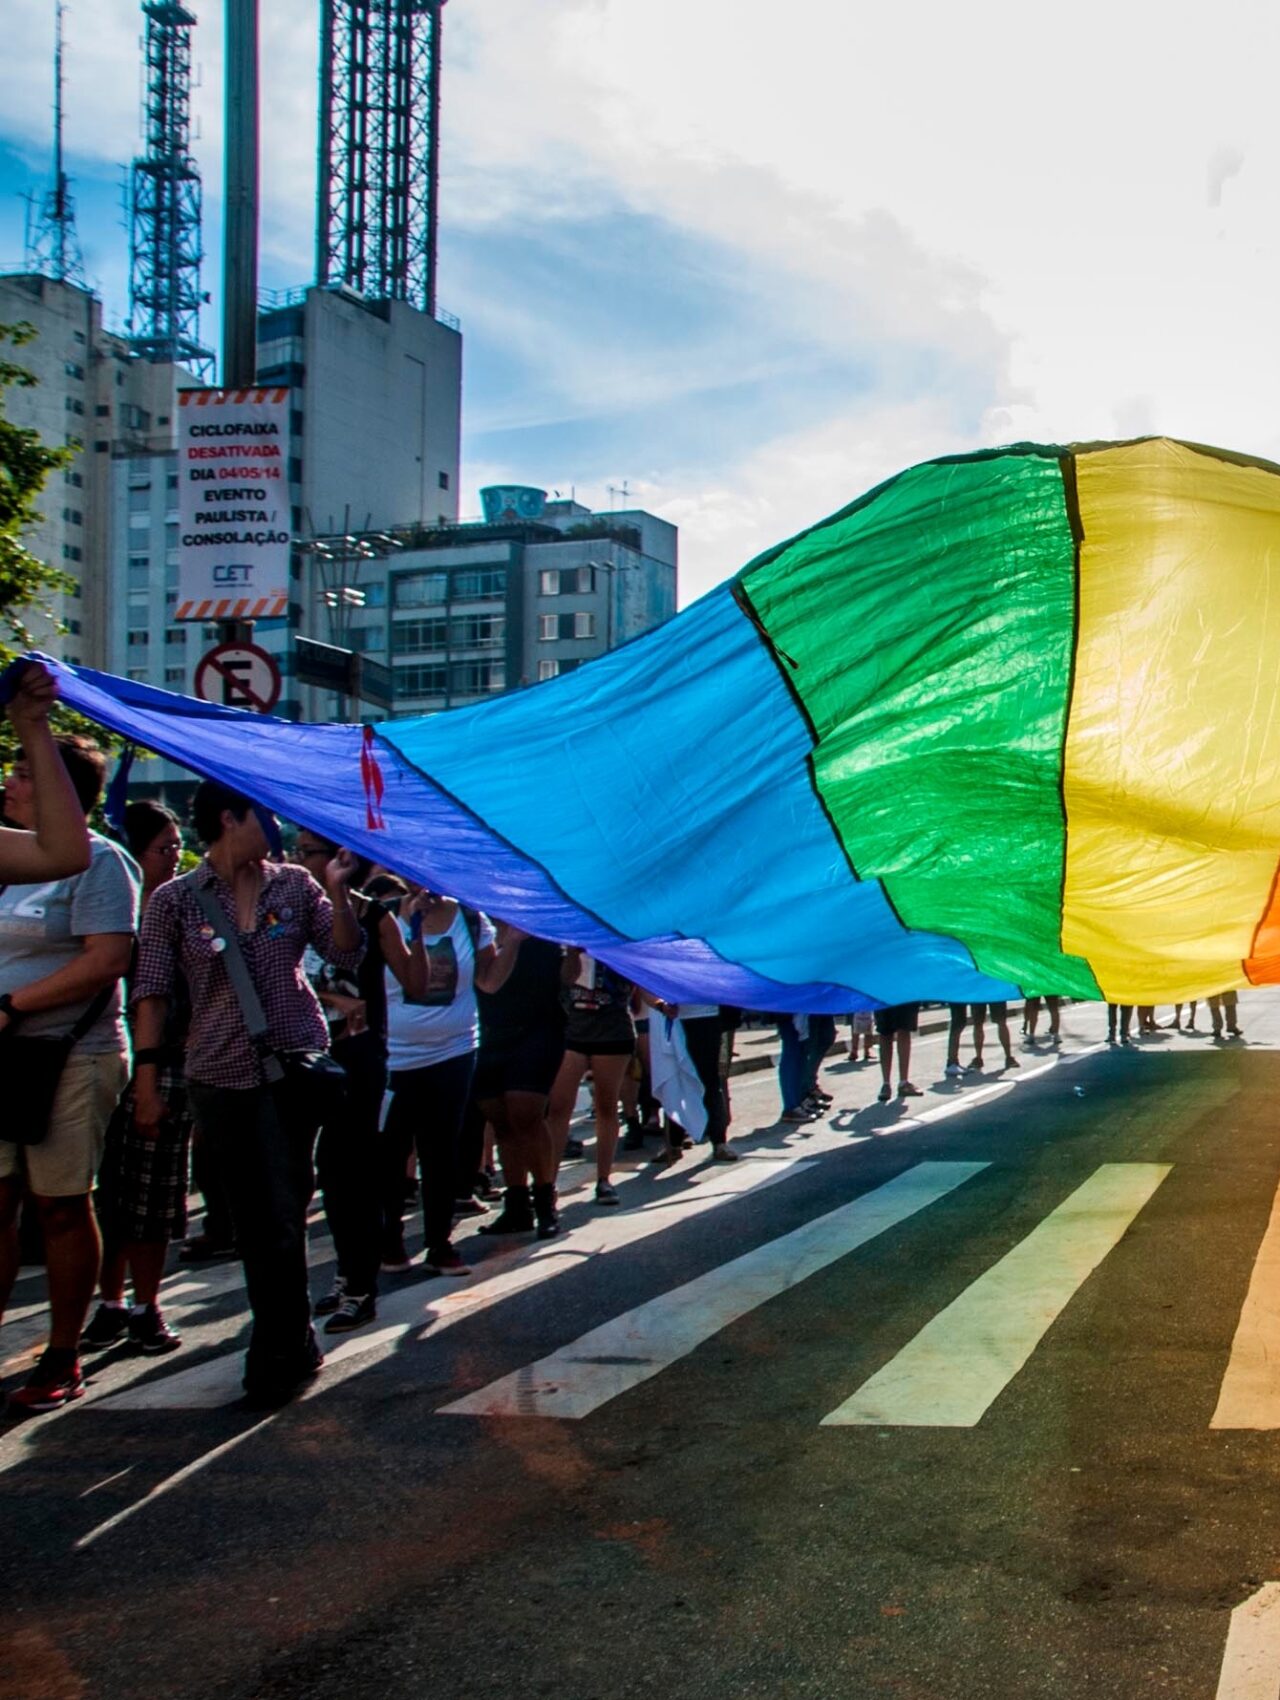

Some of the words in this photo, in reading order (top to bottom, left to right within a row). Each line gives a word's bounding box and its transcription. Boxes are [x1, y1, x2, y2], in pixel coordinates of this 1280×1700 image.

[189, 422, 279, 438] CICLOFAIXA
[187, 445, 281, 460] DESATIVADA
[190, 468, 216, 481] DIA
[218, 466, 281, 480] 04/05/14
[204, 488, 266, 502] EVENTO
[195, 510, 267, 524] PAULISTA
[182, 530, 289, 547] CONSOLAÇÃO
[212, 565, 254, 582] CET
